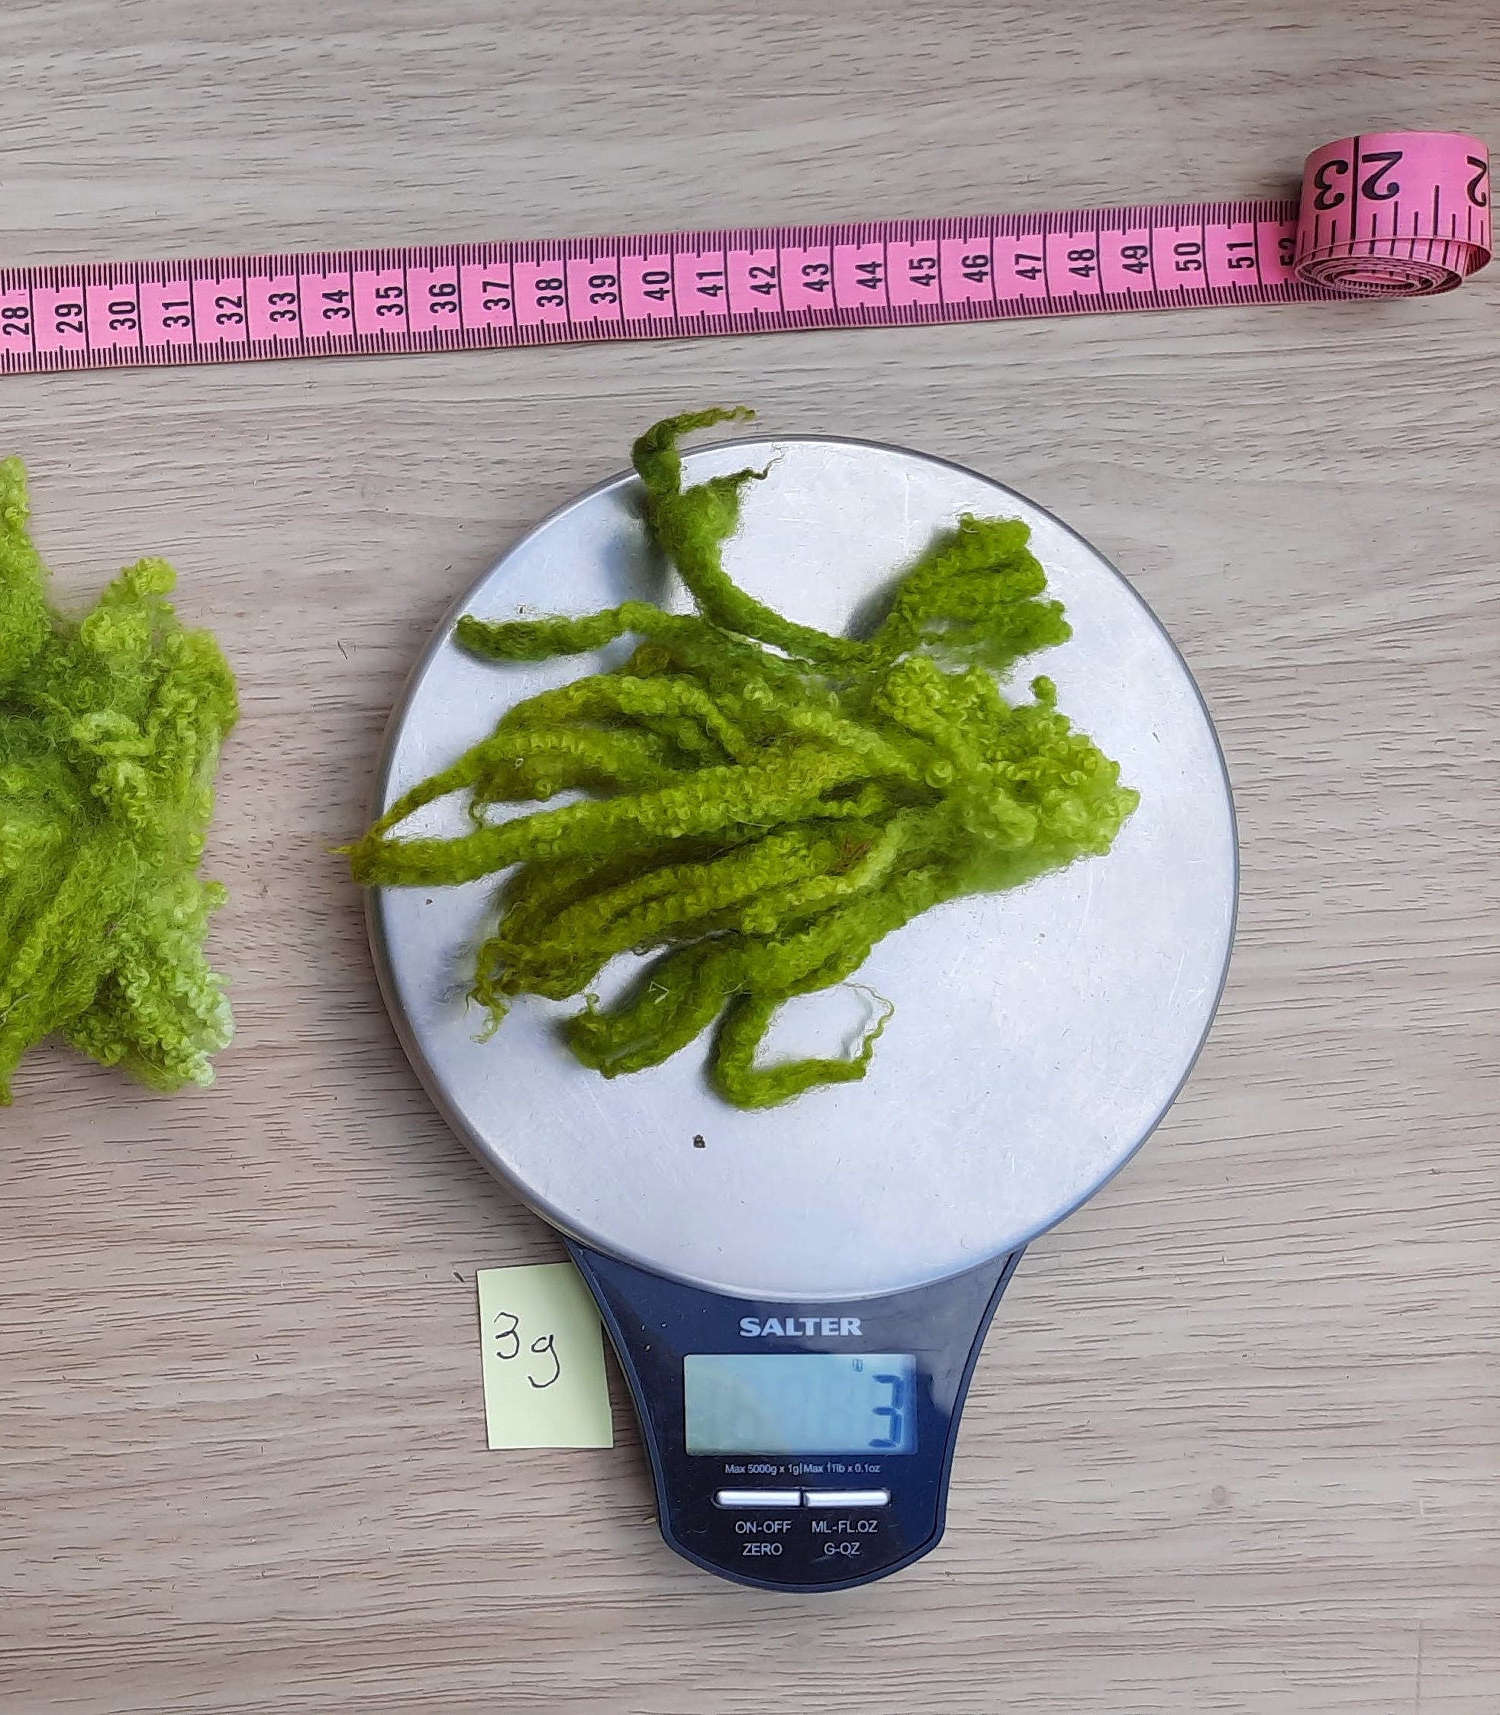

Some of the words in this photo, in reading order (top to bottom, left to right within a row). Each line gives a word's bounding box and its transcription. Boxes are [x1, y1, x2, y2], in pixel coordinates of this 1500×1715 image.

[962, 255, 989, 282] 46
[1015, 254, 1042, 280] 47
[1068, 249, 1095, 277] 48
[1121, 246, 1148, 274] 49
[1174, 243, 1202, 271] 50
[1227, 242, 1254, 269] 51
[642, 271, 670, 301] 40
[696, 272, 723, 297] 41
[749, 266, 776, 295] 42
[802, 264, 829, 292] 43
[855, 262, 883, 289] 44
[909, 258, 936, 286] 45
[376, 287, 403, 316] 35
[429, 283, 457, 313] 36
[483, 281, 510, 310] 37
[535, 278, 564, 307] 38
[589, 275, 617, 304] 39
[55, 304, 83, 333] 29
[108, 301, 136, 330] 30
[162, 301, 190, 327] 31
[215, 296, 243, 324] 32
[268, 293, 296, 322] 33
[322, 290, 350, 319] 34
[2, 307, 29, 335] 28
[739, 1317, 863, 1337] SALTER
[868, 1374, 904, 1448] 3
[724, 1463, 746, 1474] Max
[747, 1463, 778, 1476] 5000g
[854, 1463, 881, 1473] 0.1oz
[735, 1520, 792, 1534] ON-OFF
[811, 1520, 878, 1533] ML-FL.OZ
[742, 1543, 783, 1556] ZERO
[823, 1542, 861, 1555] G-OZ
